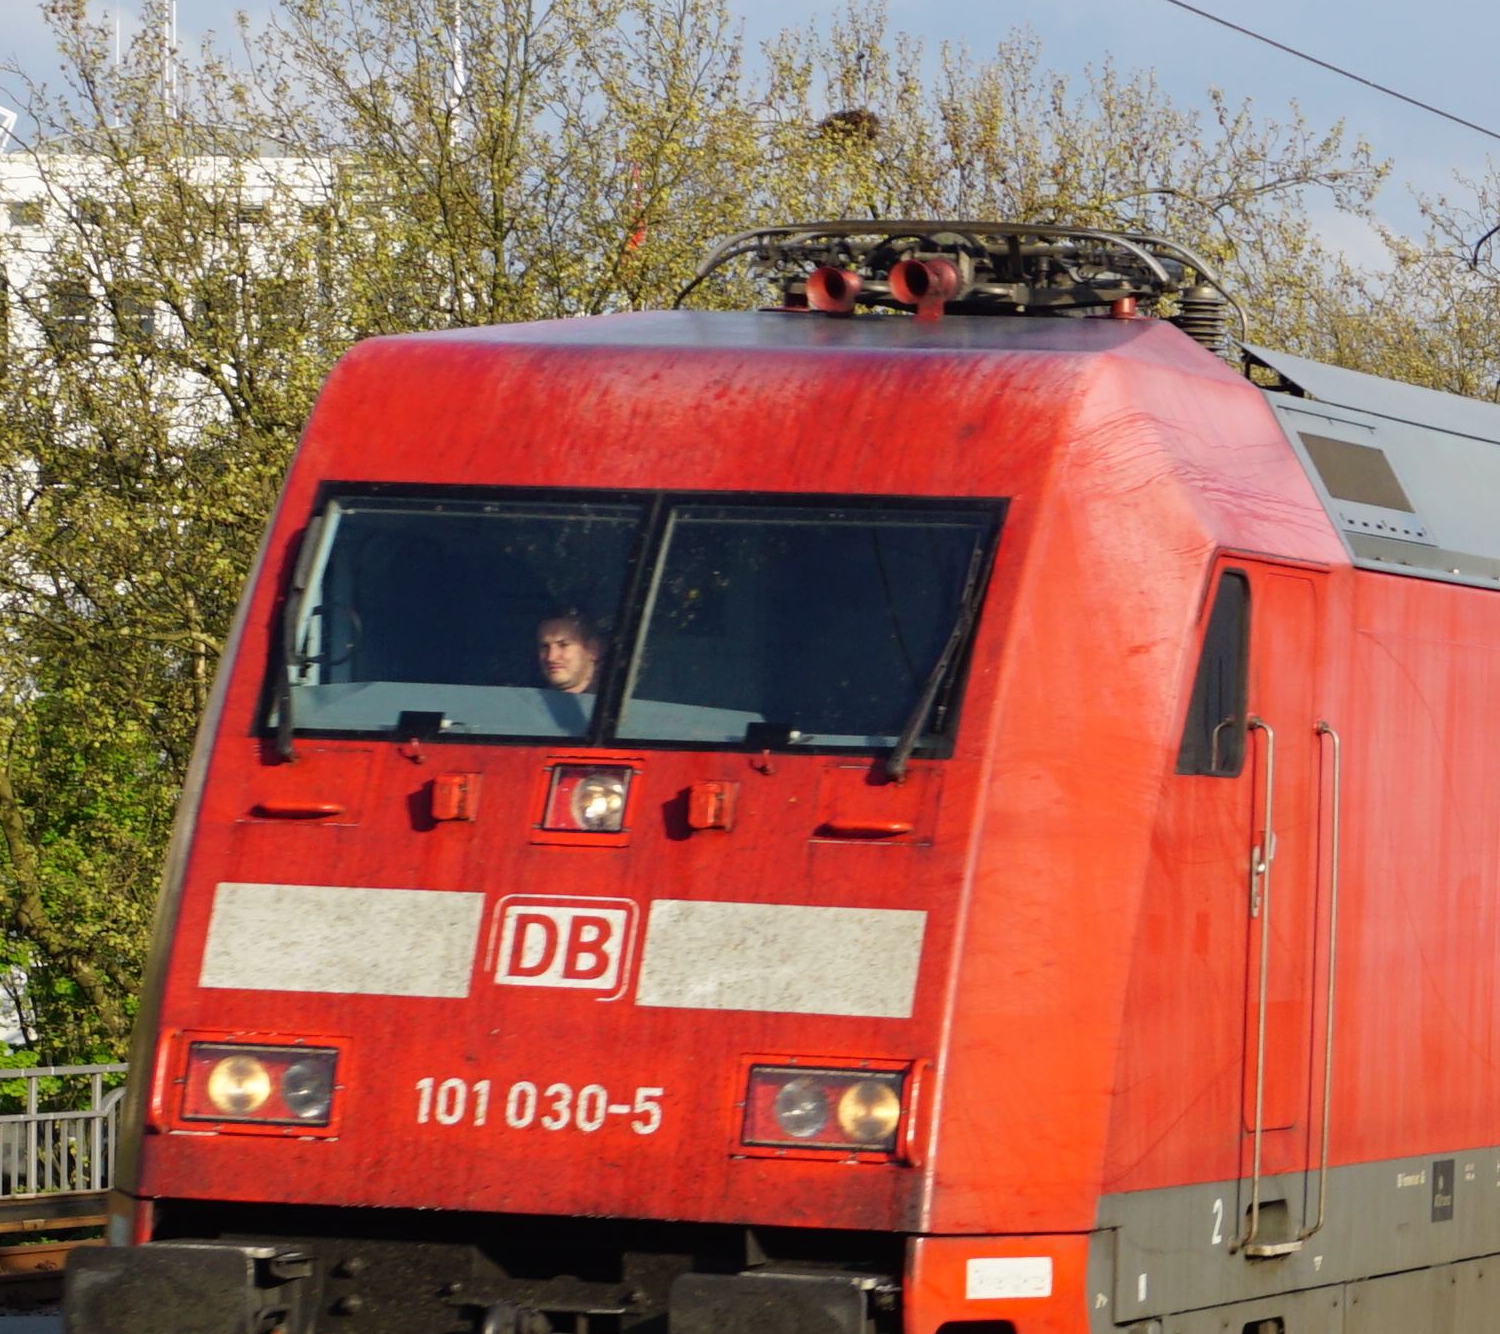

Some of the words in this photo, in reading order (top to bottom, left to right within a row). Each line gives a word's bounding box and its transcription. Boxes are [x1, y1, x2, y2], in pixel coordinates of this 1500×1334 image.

[506, 913, 613, 980] DB
[415, 1077, 491, 1127] 101
[505, 1080, 665, 1135] 030-5
[1211, 1197, 1223, 1245] 2
